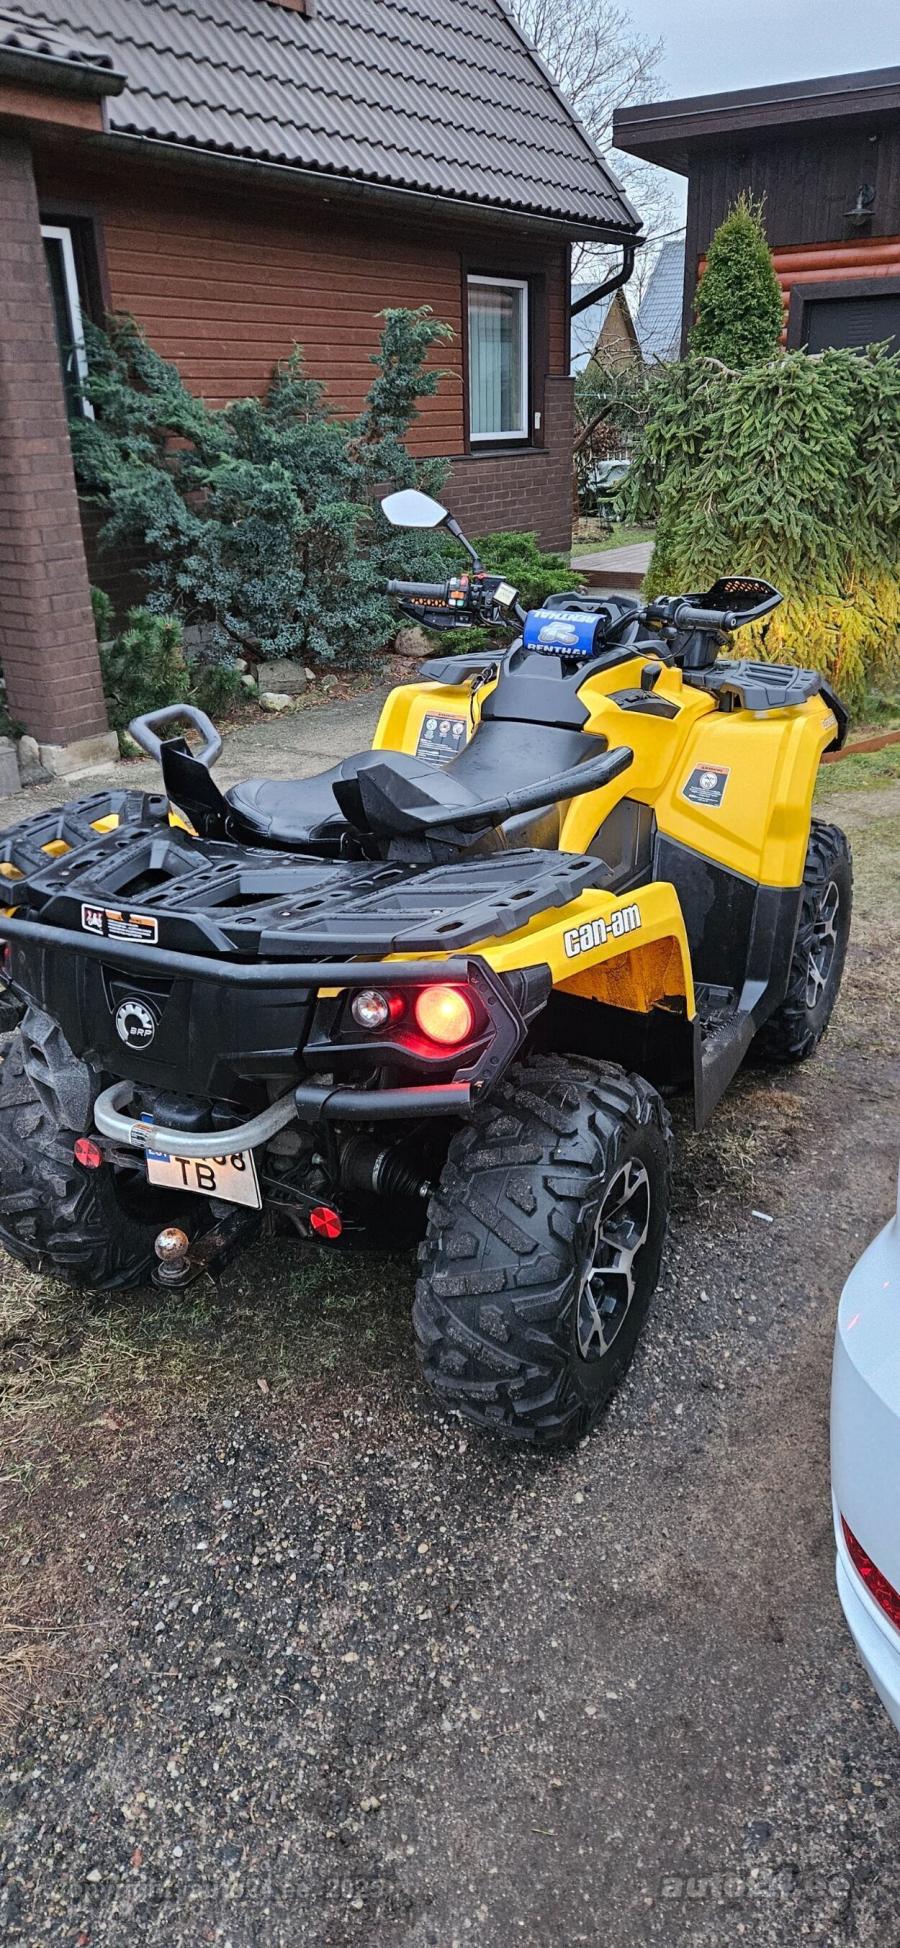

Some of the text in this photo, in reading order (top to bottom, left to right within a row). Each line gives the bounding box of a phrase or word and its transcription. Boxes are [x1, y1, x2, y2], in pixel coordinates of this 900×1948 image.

[527, 643, 587, 656] RENTHAL
[130, 1026, 152, 1037] BRP
[174, 1157, 217, 1191] TB
